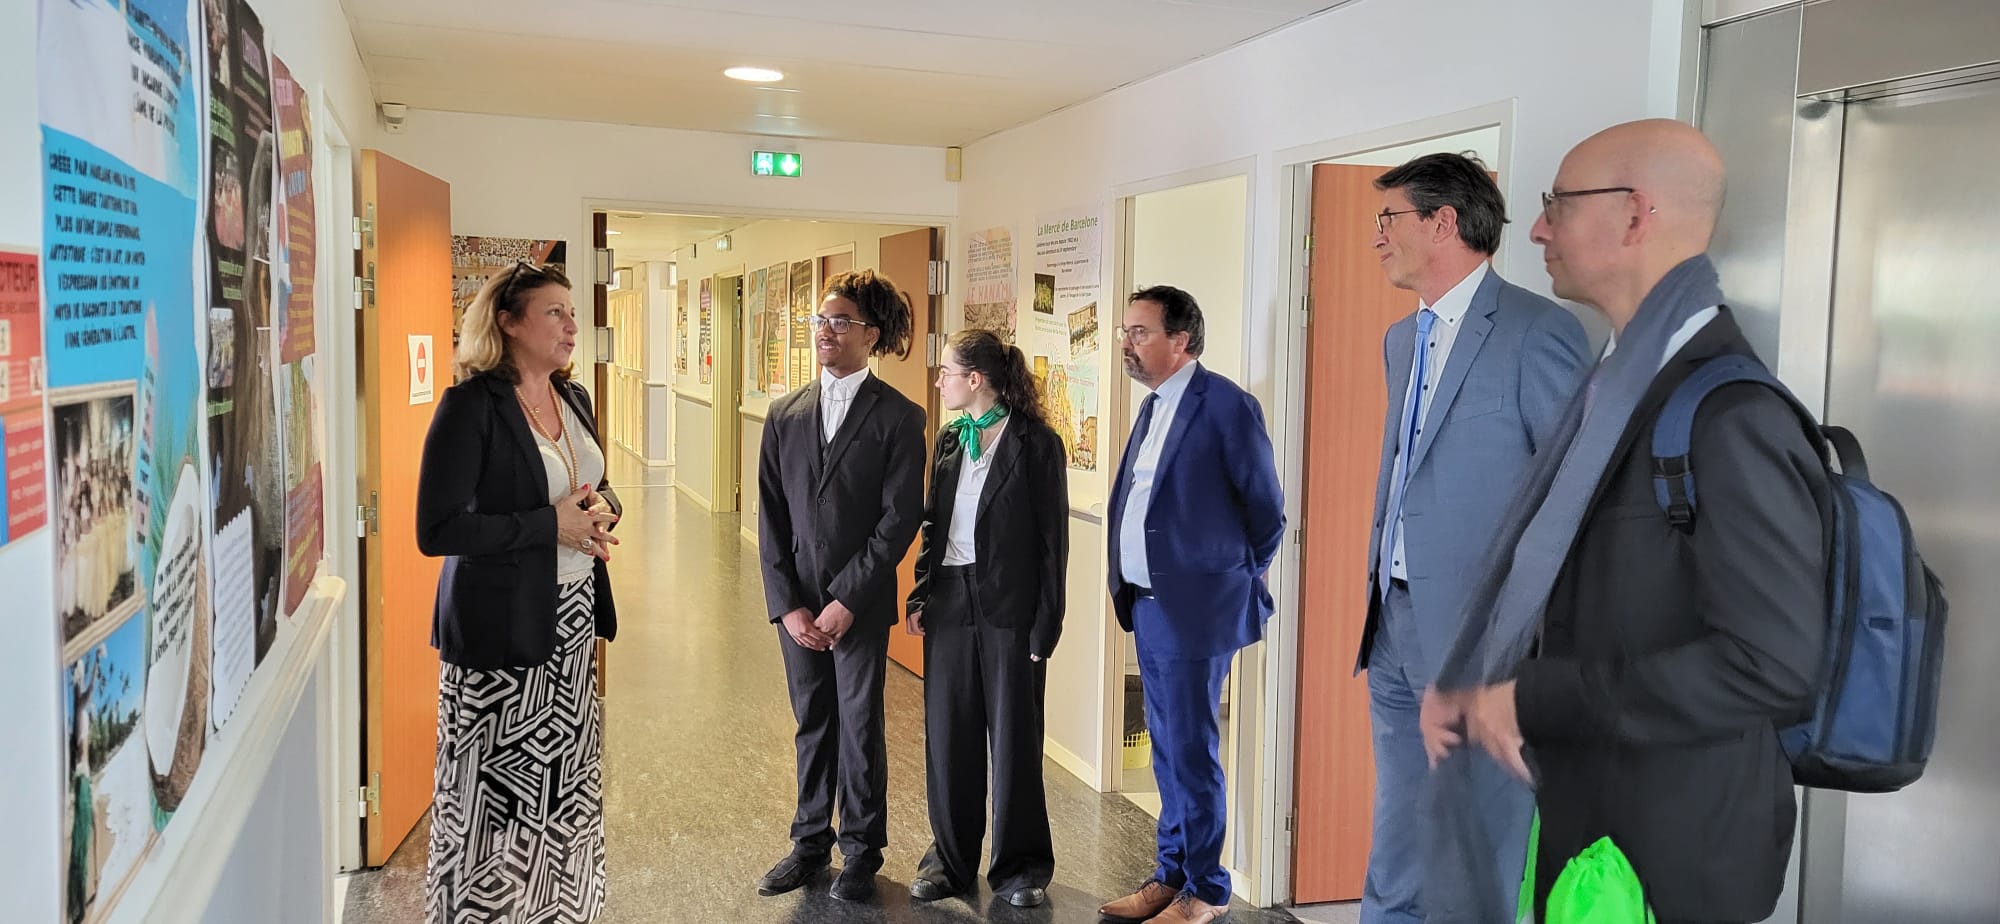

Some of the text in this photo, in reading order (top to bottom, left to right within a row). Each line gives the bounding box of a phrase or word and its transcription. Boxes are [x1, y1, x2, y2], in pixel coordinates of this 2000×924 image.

[74, 158, 88, 176] PAR
[53, 184, 76, 205] CETTE
[79, 188, 97, 208] DANSE
[55, 214, 73, 233] PLUS
[1061, 220, 1069, 232] de
[1070, 216, 1098, 231] Barcelone
